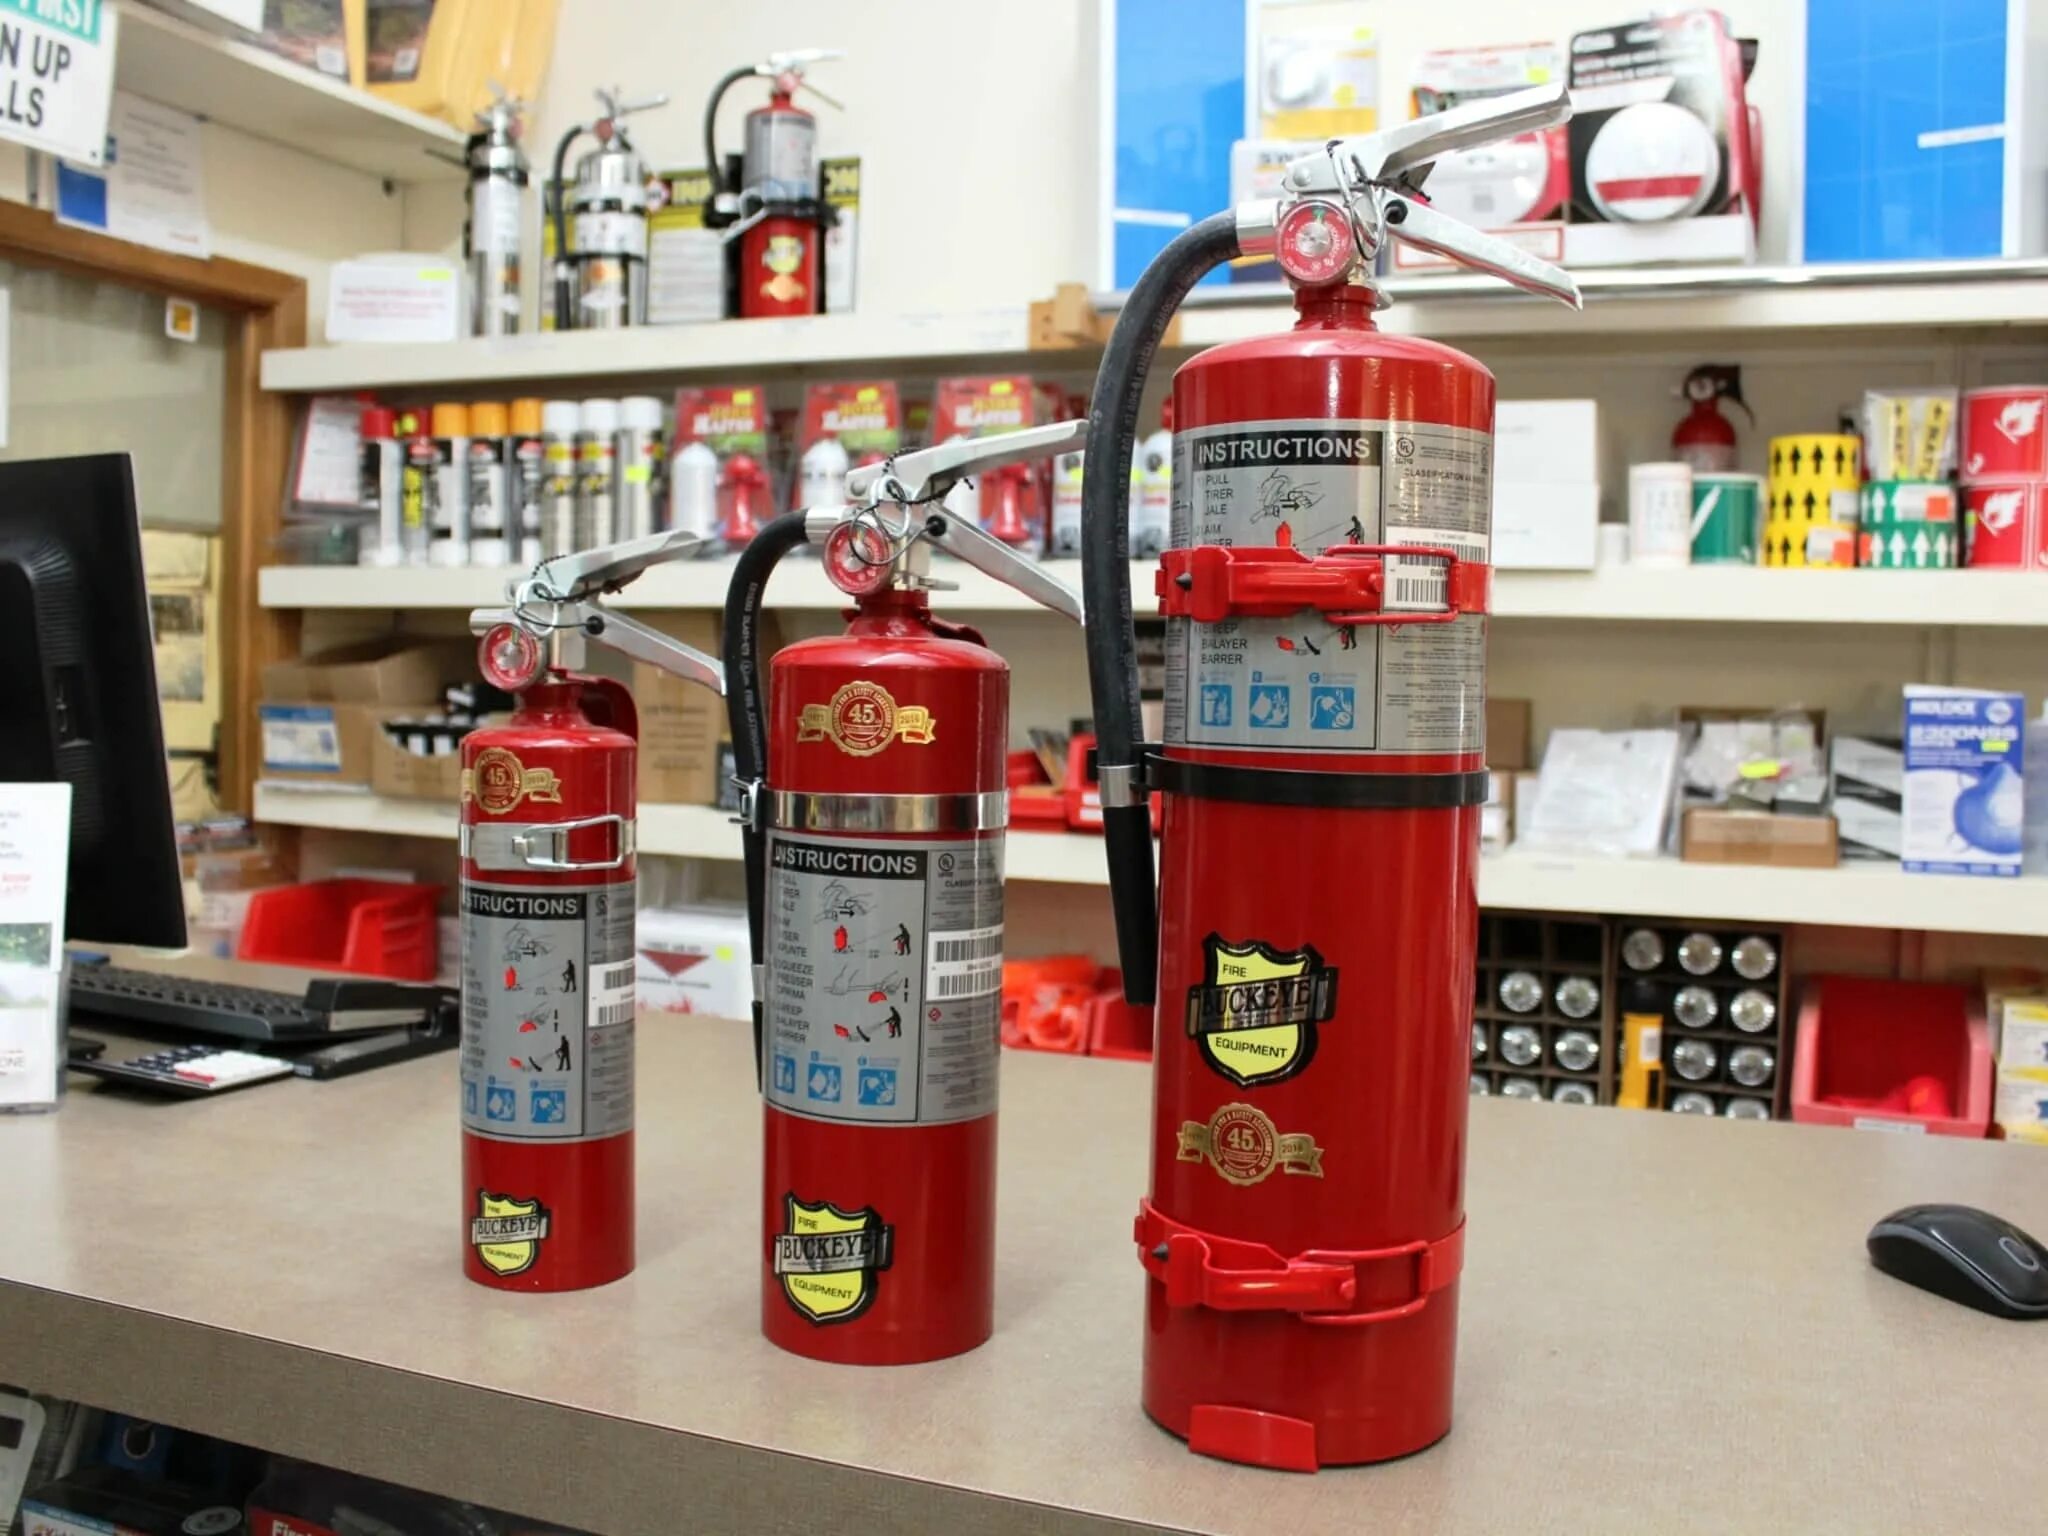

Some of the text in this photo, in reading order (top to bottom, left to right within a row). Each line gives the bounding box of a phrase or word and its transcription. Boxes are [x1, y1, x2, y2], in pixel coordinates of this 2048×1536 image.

[33, 35, 71, 83] UP
[0, 80, 44, 128] LS
[1198, 437, 1371, 464] INSTRUCTIONS
[1206, 474, 1229, 486] PULL
[1205, 488, 1233, 499] TIRER
[1205, 503, 1227, 515] JALE
[1201, 638, 1248, 649] BALAYER
[1201, 653, 1243, 664] BARRER
[848, 703, 876, 724] 45
[775, 845, 918, 874] INSTRUCTIONS
[1222, 963, 1247, 977] FIRE
[1203, 976, 1312, 1015] BUCKEYE
[1215, 1036, 1288, 1058] EQUIPMENT
[1227, 1127, 1256, 1151] 45
[478, 1216, 537, 1235] BUCKEYE
[797, 1216, 818, 1230] FIRE
[783, 1233, 873, 1260] BUCKEYE
[793, 1278, 853, 1300] EQUIPMENT
